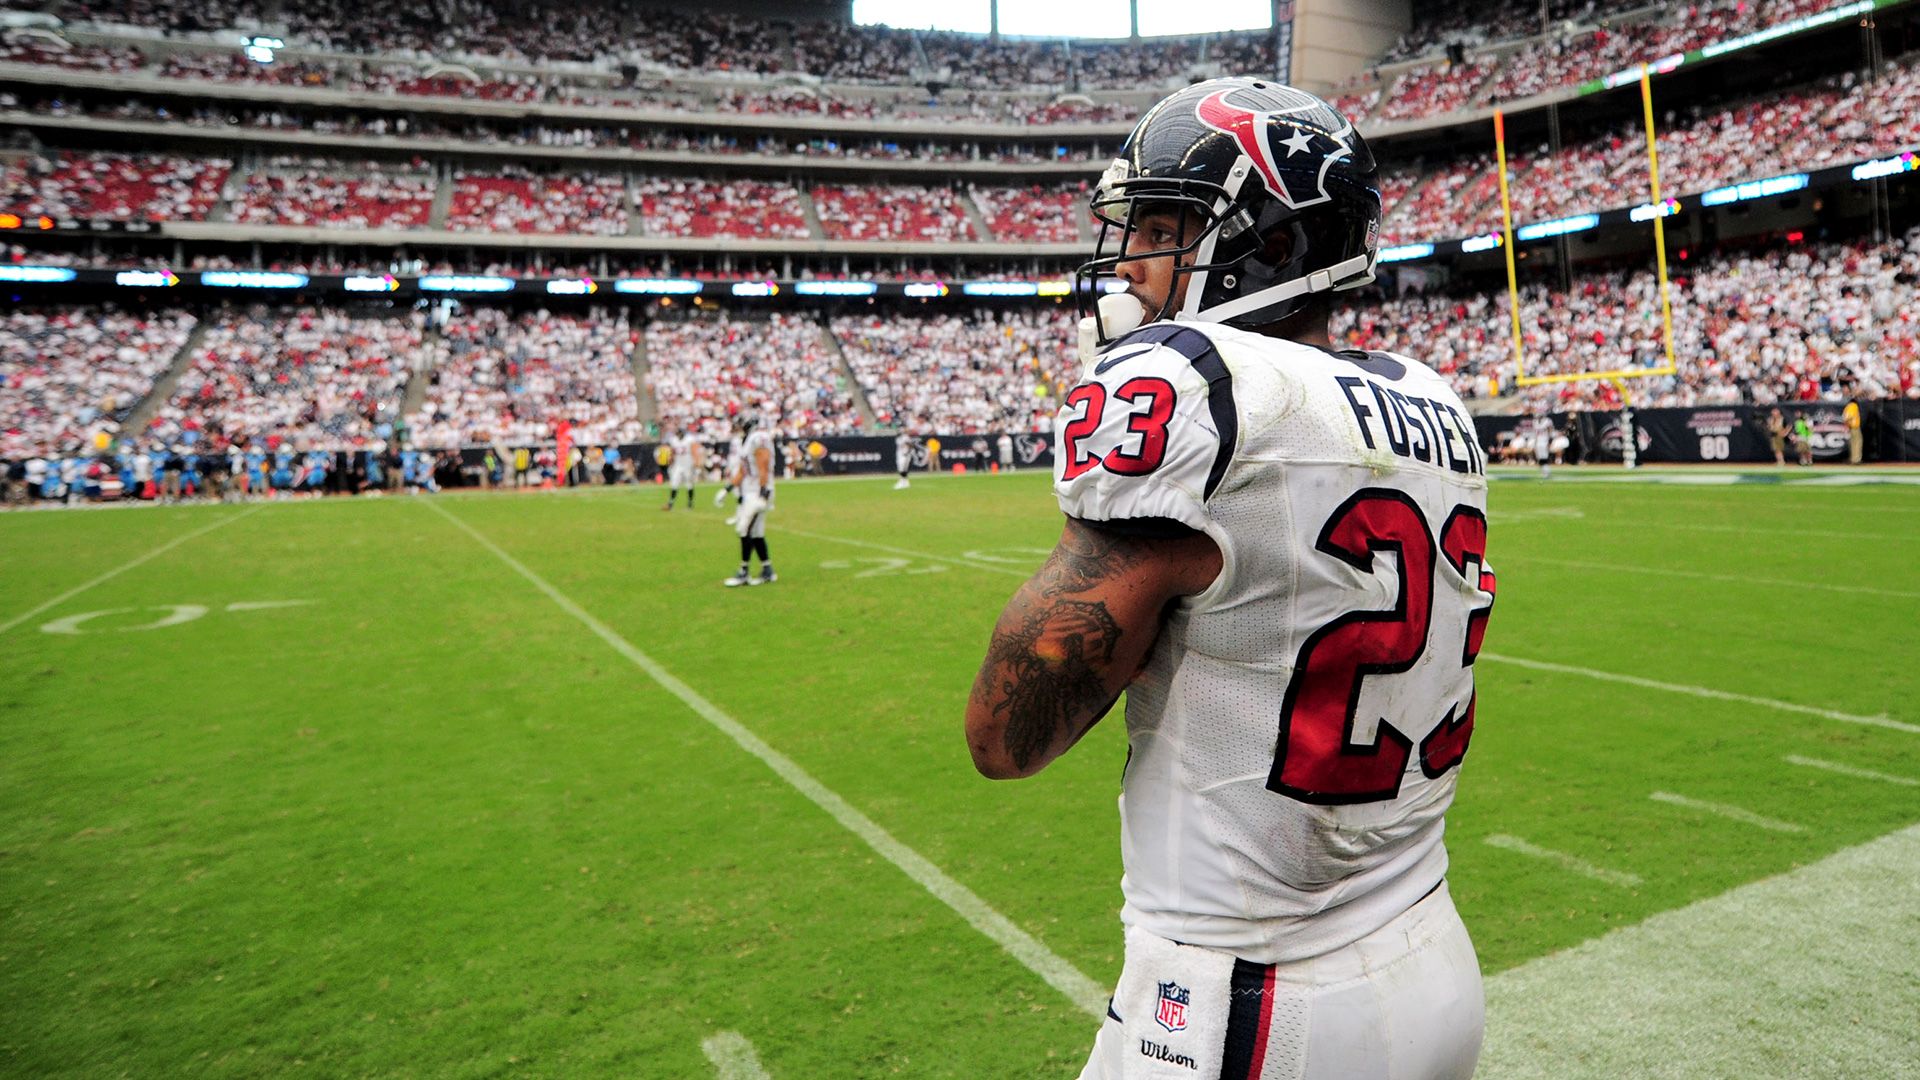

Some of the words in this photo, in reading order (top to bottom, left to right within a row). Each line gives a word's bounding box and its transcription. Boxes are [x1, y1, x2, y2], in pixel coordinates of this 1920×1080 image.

[1061, 376, 1177, 481] 23
[1335, 376, 1483, 476] FOSTER
[1266, 487, 1496, 805] 23
[1141, 1039, 1198, 1070] Wilson
[1158, 999, 1186, 1027] NFL
